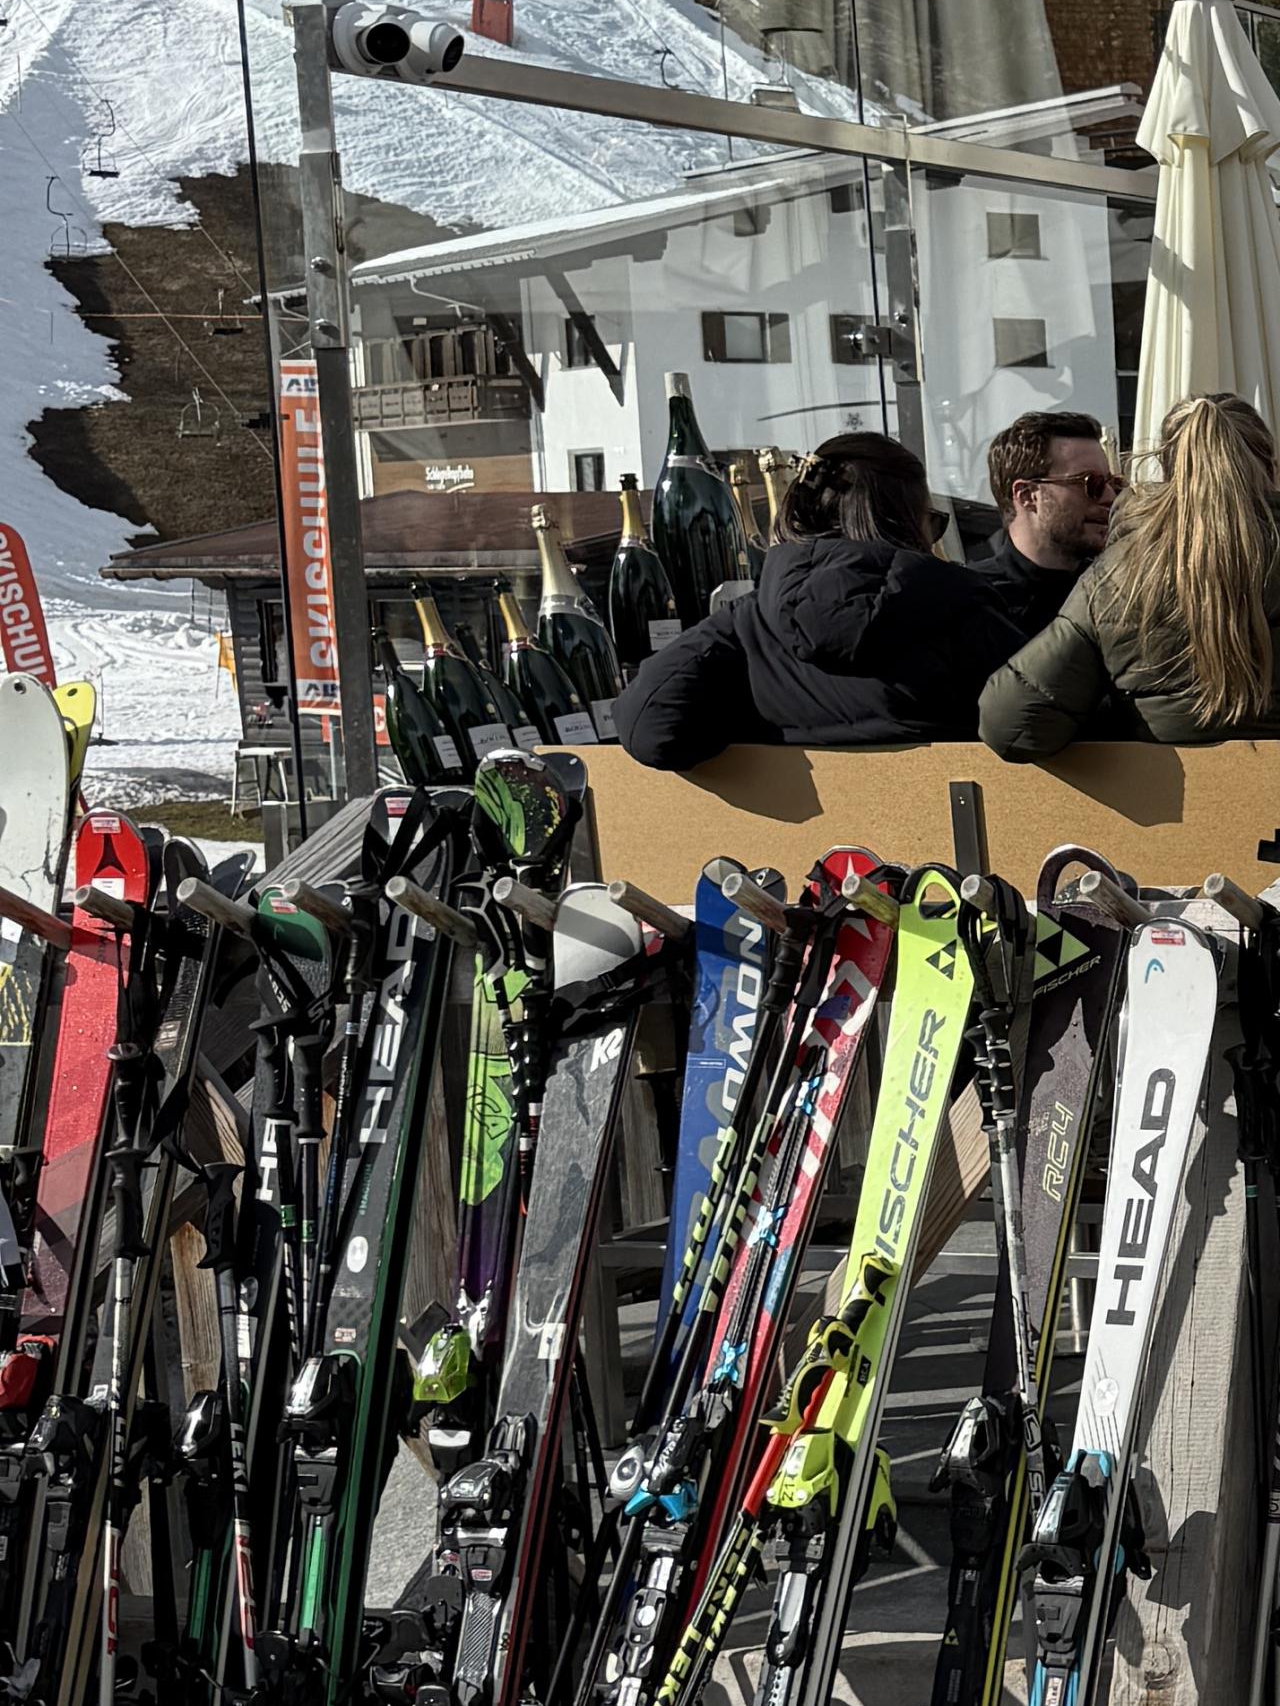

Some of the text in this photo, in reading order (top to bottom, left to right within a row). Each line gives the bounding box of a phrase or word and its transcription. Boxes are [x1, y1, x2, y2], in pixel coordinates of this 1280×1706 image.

[1033, 954, 1102, 1000] FISCHER
[590, 1027, 628, 1073] K2
[873, 1007, 947, 1259] ISCHER
[1042, 1100, 1075, 1203] RC4
[1105, 1067, 1177, 1326] HEAD
